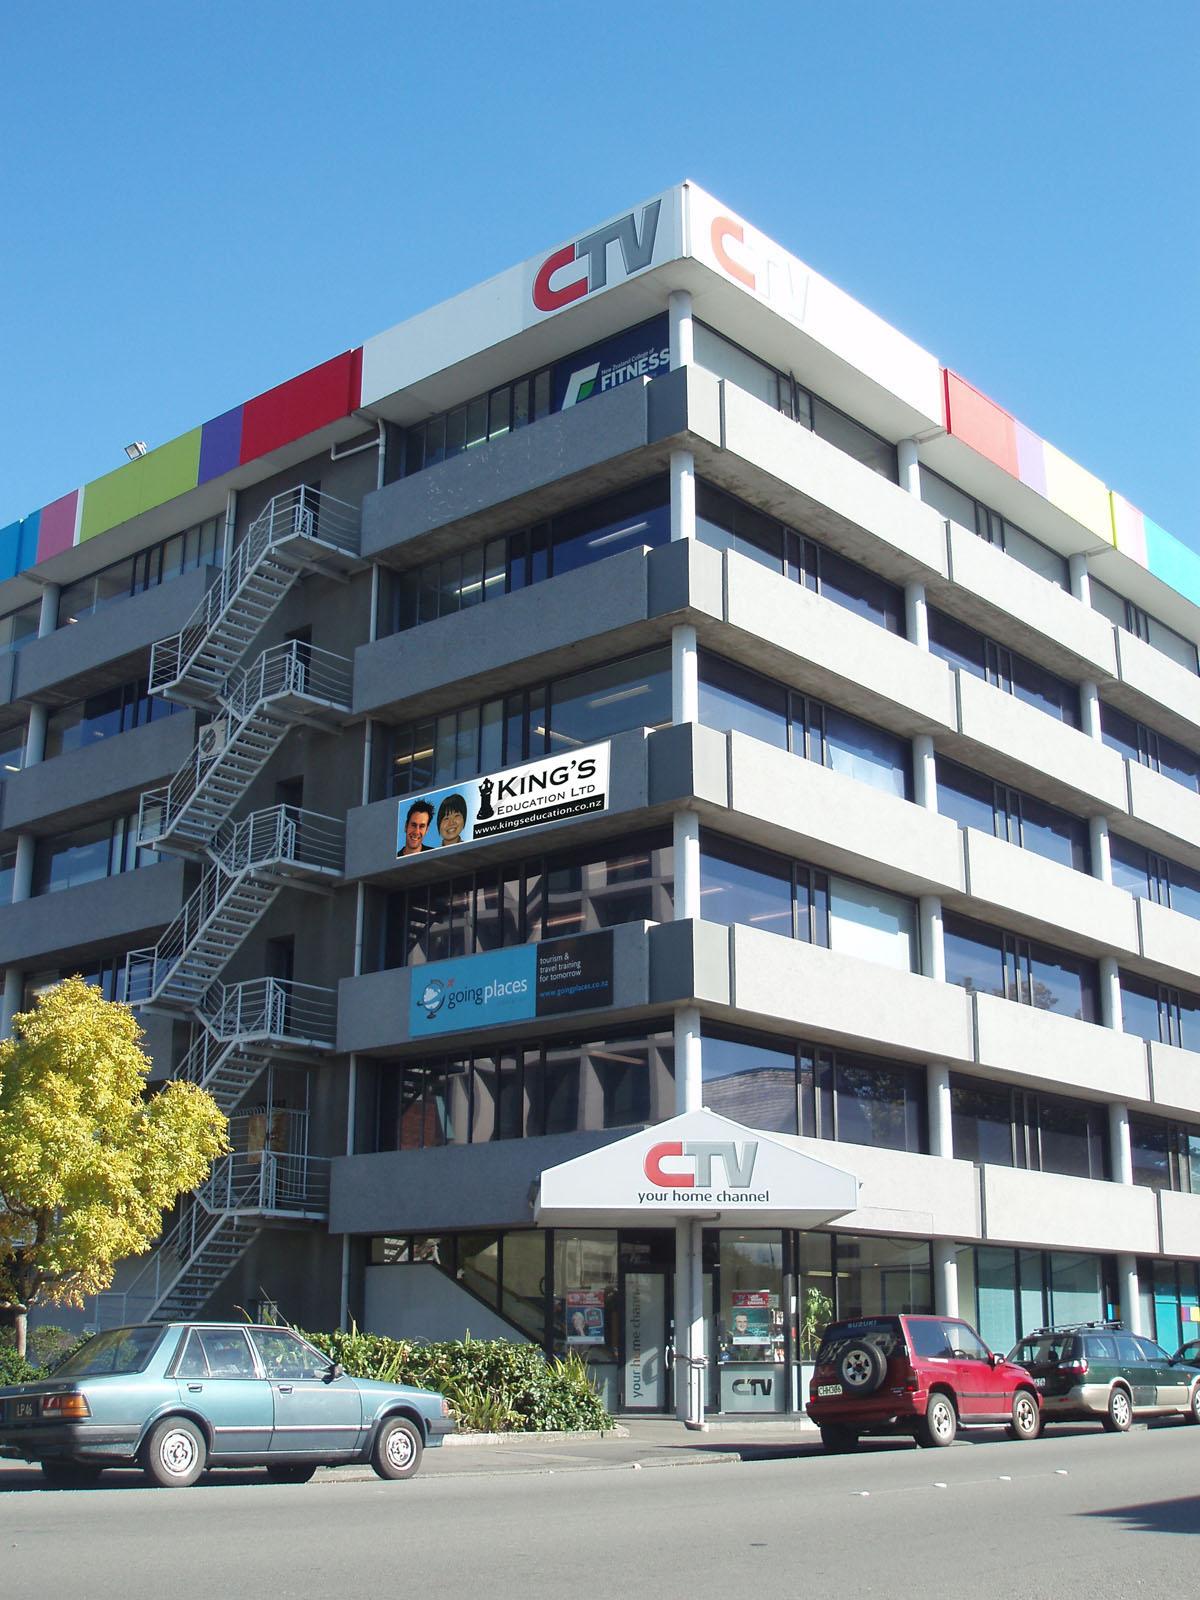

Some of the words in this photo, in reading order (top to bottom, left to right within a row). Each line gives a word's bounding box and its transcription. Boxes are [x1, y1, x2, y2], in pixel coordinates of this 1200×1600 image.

[532, 199, 662, 312] CTV
[601, 348, 670, 392] FITNESS
[498, 759, 596, 800] KING'S
[497, 791, 566, 815] EDUCATION
[474, 800, 602, 836] www.kingseducation.co.nz
[540, 955, 563, 964] tourism
[564, 952, 569, 960] &
[540, 964, 557, 973] travel
[559, 961, 581, 970] training
[540, 974, 549, 983] for
[550, 970, 581, 980] tomorrow
[643, 1141, 758, 1188] CTV
[638, 1192, 669, 1203] your
[672, 1190, 712, 1202] home
[716, 1190, 769, 1202] channel
[632, 1372, 643, 1398] your
[732, 1378, 772, 1396] CTV
